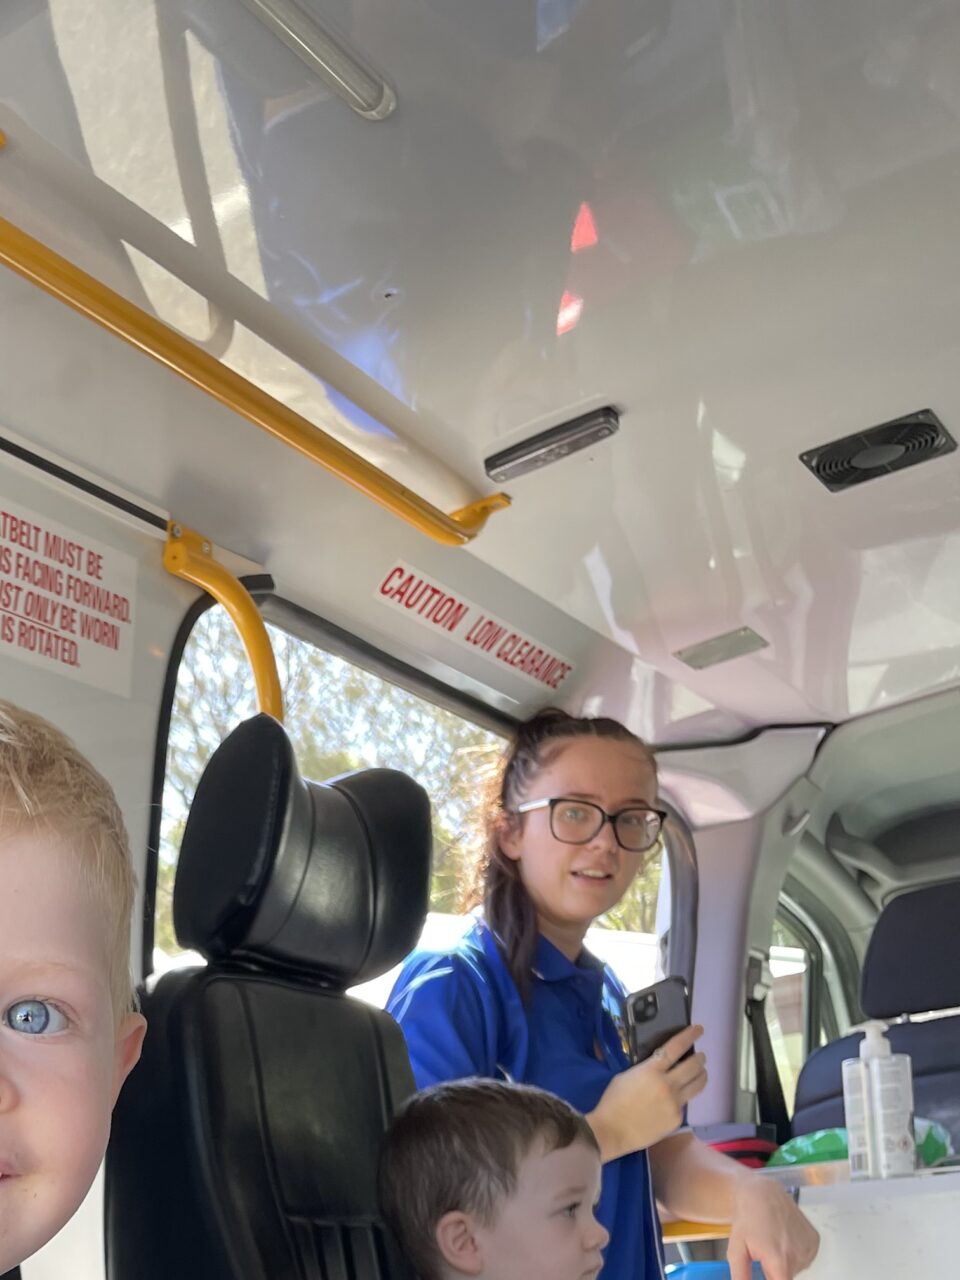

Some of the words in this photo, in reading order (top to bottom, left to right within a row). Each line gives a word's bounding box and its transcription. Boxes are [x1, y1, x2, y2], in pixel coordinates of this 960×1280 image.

[44, 531, 84, 571] MUST
[87, 550, 103, 580] BE
[15, 552, 64, 597] FACING
[66, 574, 132, 624] FORWARD.
[1, 614, 15, 643] IS
[18, 621, 81, 667] ROTATED.
[24, 591, 60, 626] ONLY
[60, 604, 77, 634] BE
[80, 611, 120, 650] WORN
[379, 567, 470, 632] CAUTION
[465, 615, 507, 652] LOW
[496, 633, 572, 689] CLEARANCE
